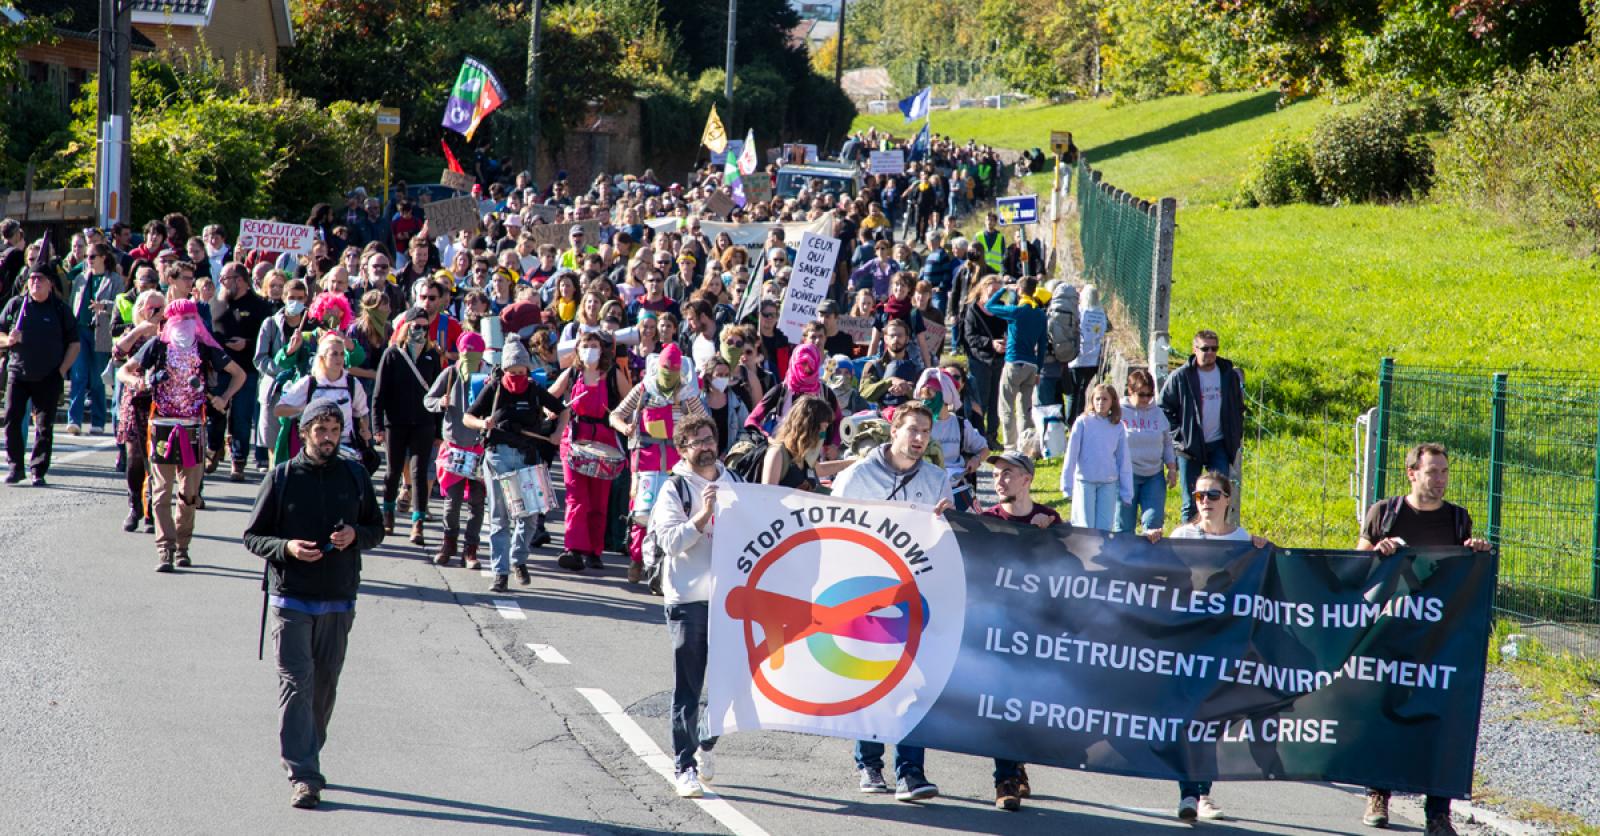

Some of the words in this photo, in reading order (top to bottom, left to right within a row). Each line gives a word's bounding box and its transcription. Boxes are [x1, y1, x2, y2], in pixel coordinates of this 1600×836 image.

[243, 220, 309, 238] REVOLUTION
[254, 235, 301, 250] TOTALE
[808, 237, 834, 252] CEUX
[807, 250, 826, 263] QUI
[798, 262, 831, 279] SAVENT
[802, 276, 817, 290] SE
[736, 518, 785, 575] STOP
[790, 505, 872, 529] TOTAL
[876, 517, 934, 576] NOW!
[995, 567, 1041, 593] ILS
[1048, 575, 1166, 608] VIOLENT
[1171, 588, 1226, 614] LES
[1232, 593, 1315, 627] DROITS
[1322, 595, 1444, 628] HUMAINS
[985, 627, 1029, 655] ILS
[1035, 632, 1214, 679] DÉTRUISENT
[1217, 655, 1457, 693] L'ENVIRONEMENT
[977, 693, 1023, 722] ILS
[1028, 700, 1184, 742] PROFITENT
[1187, 719, 1220, 743] DE
[1223, 719, 1256, 742] LA
[1261, 719, 1339, 745] CRISE
